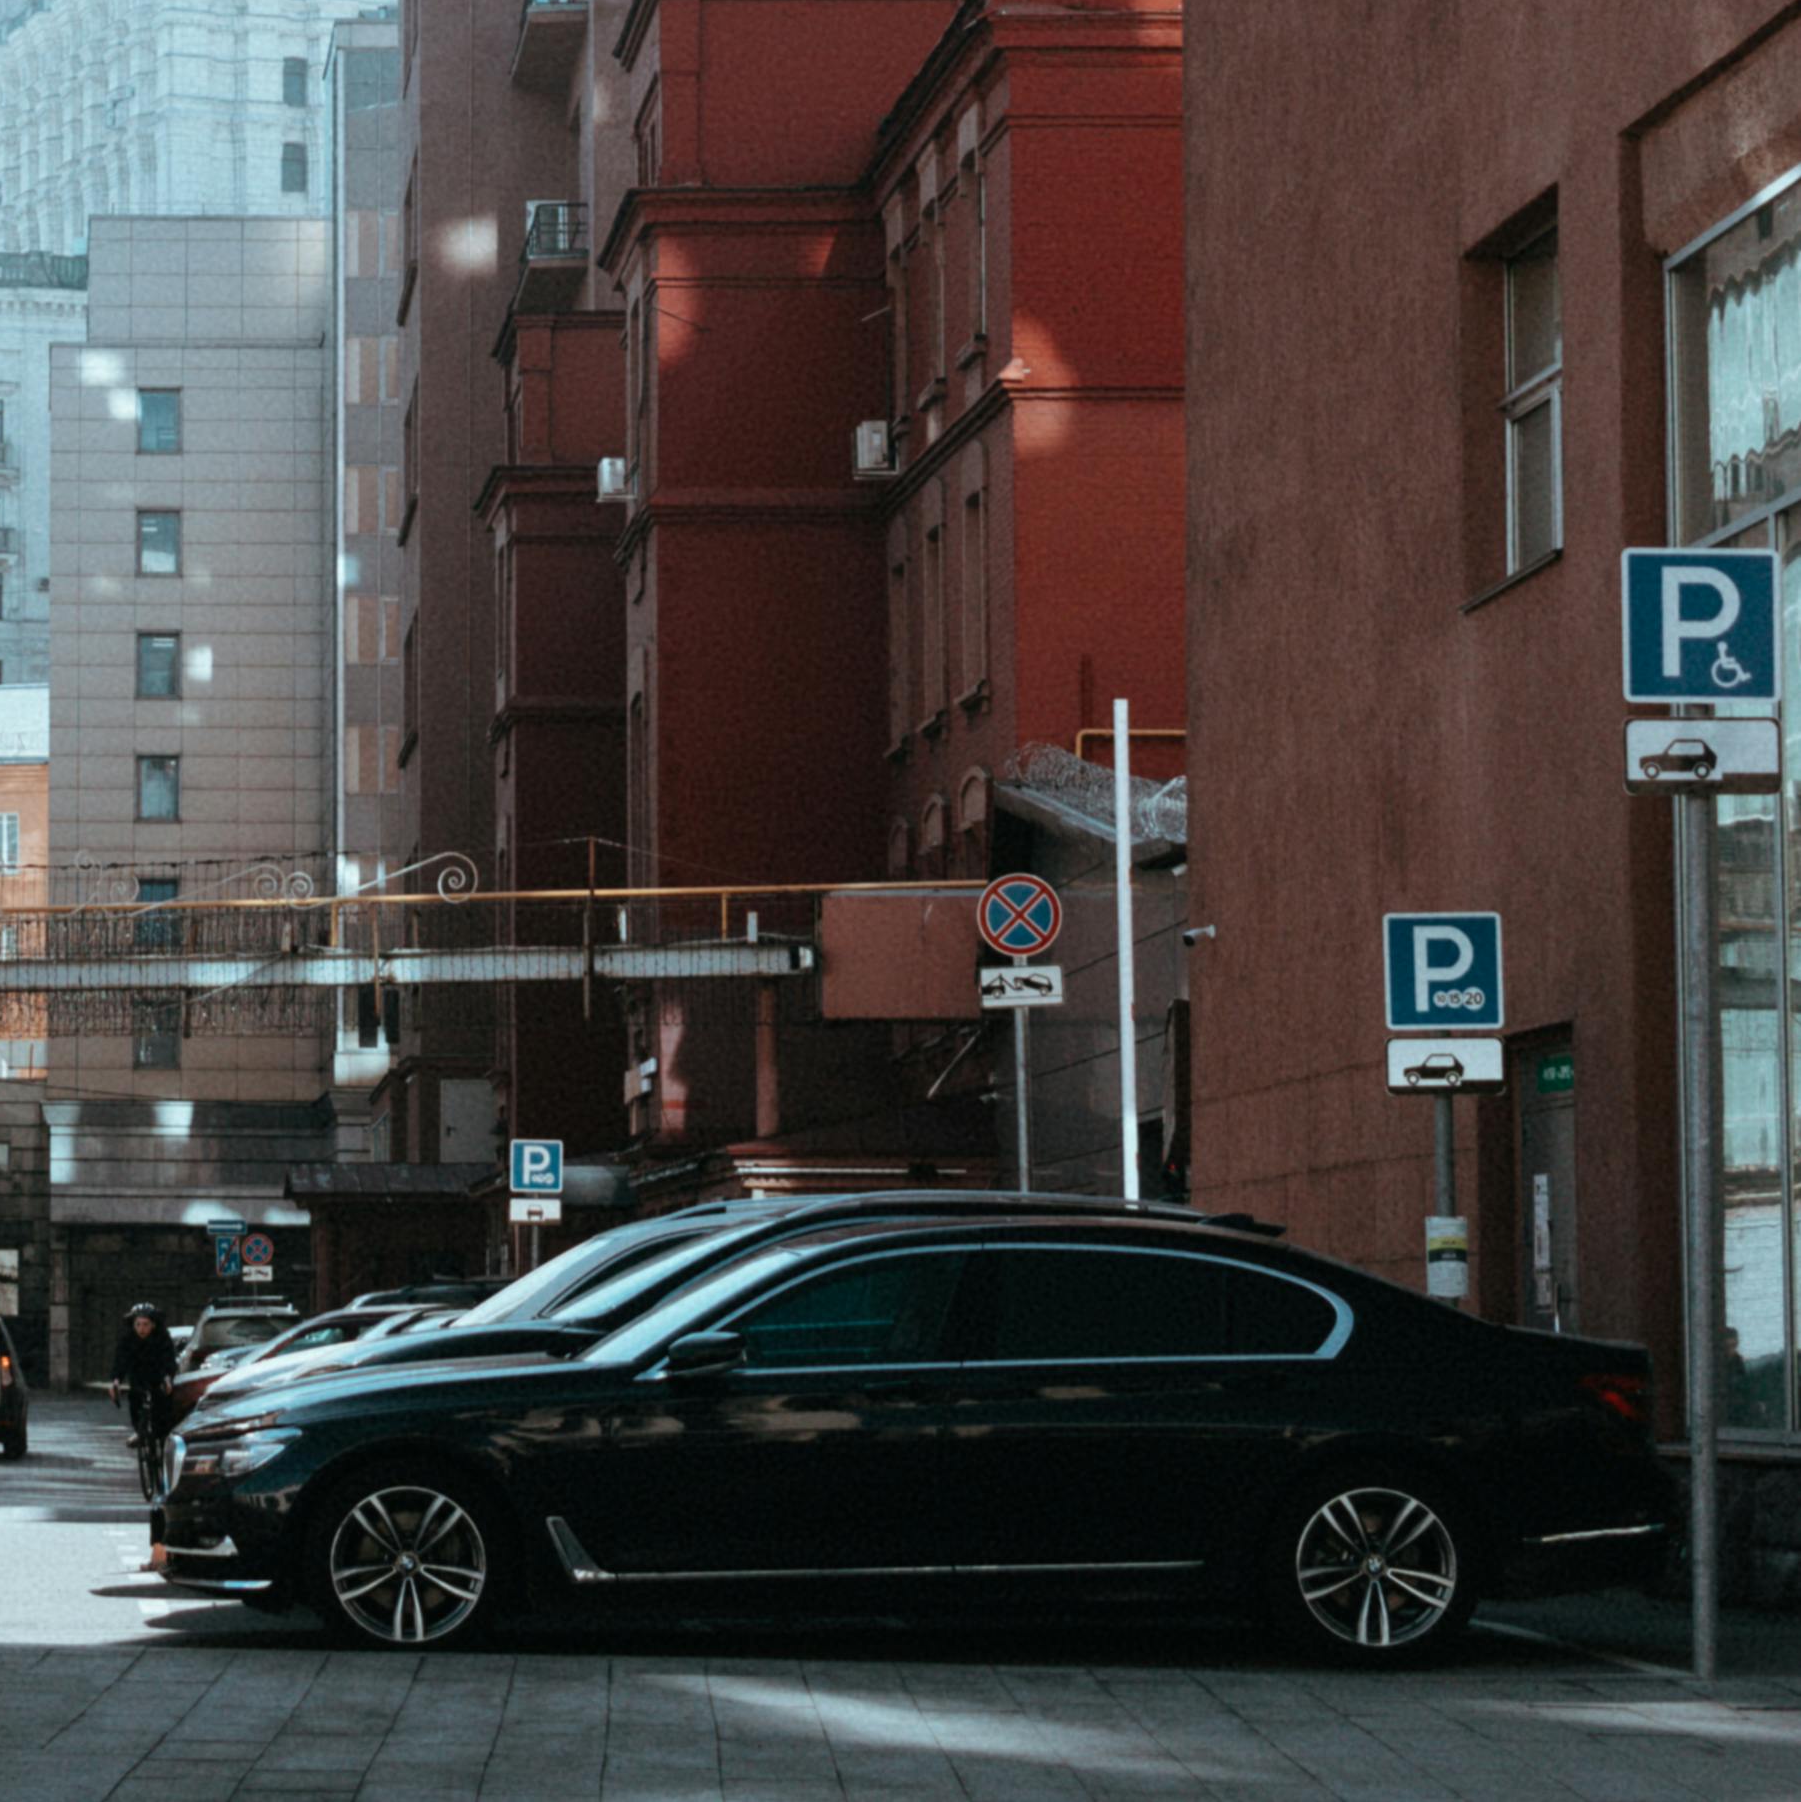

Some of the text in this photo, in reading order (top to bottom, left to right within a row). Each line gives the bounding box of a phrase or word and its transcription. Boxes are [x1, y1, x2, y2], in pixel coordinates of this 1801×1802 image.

[1661, 565, 1741, 677] P
[1413, 925, 1474, 1012] P
[1465, 992, 1483, 1005] 20
[522, 1145, 551, 1185] P
